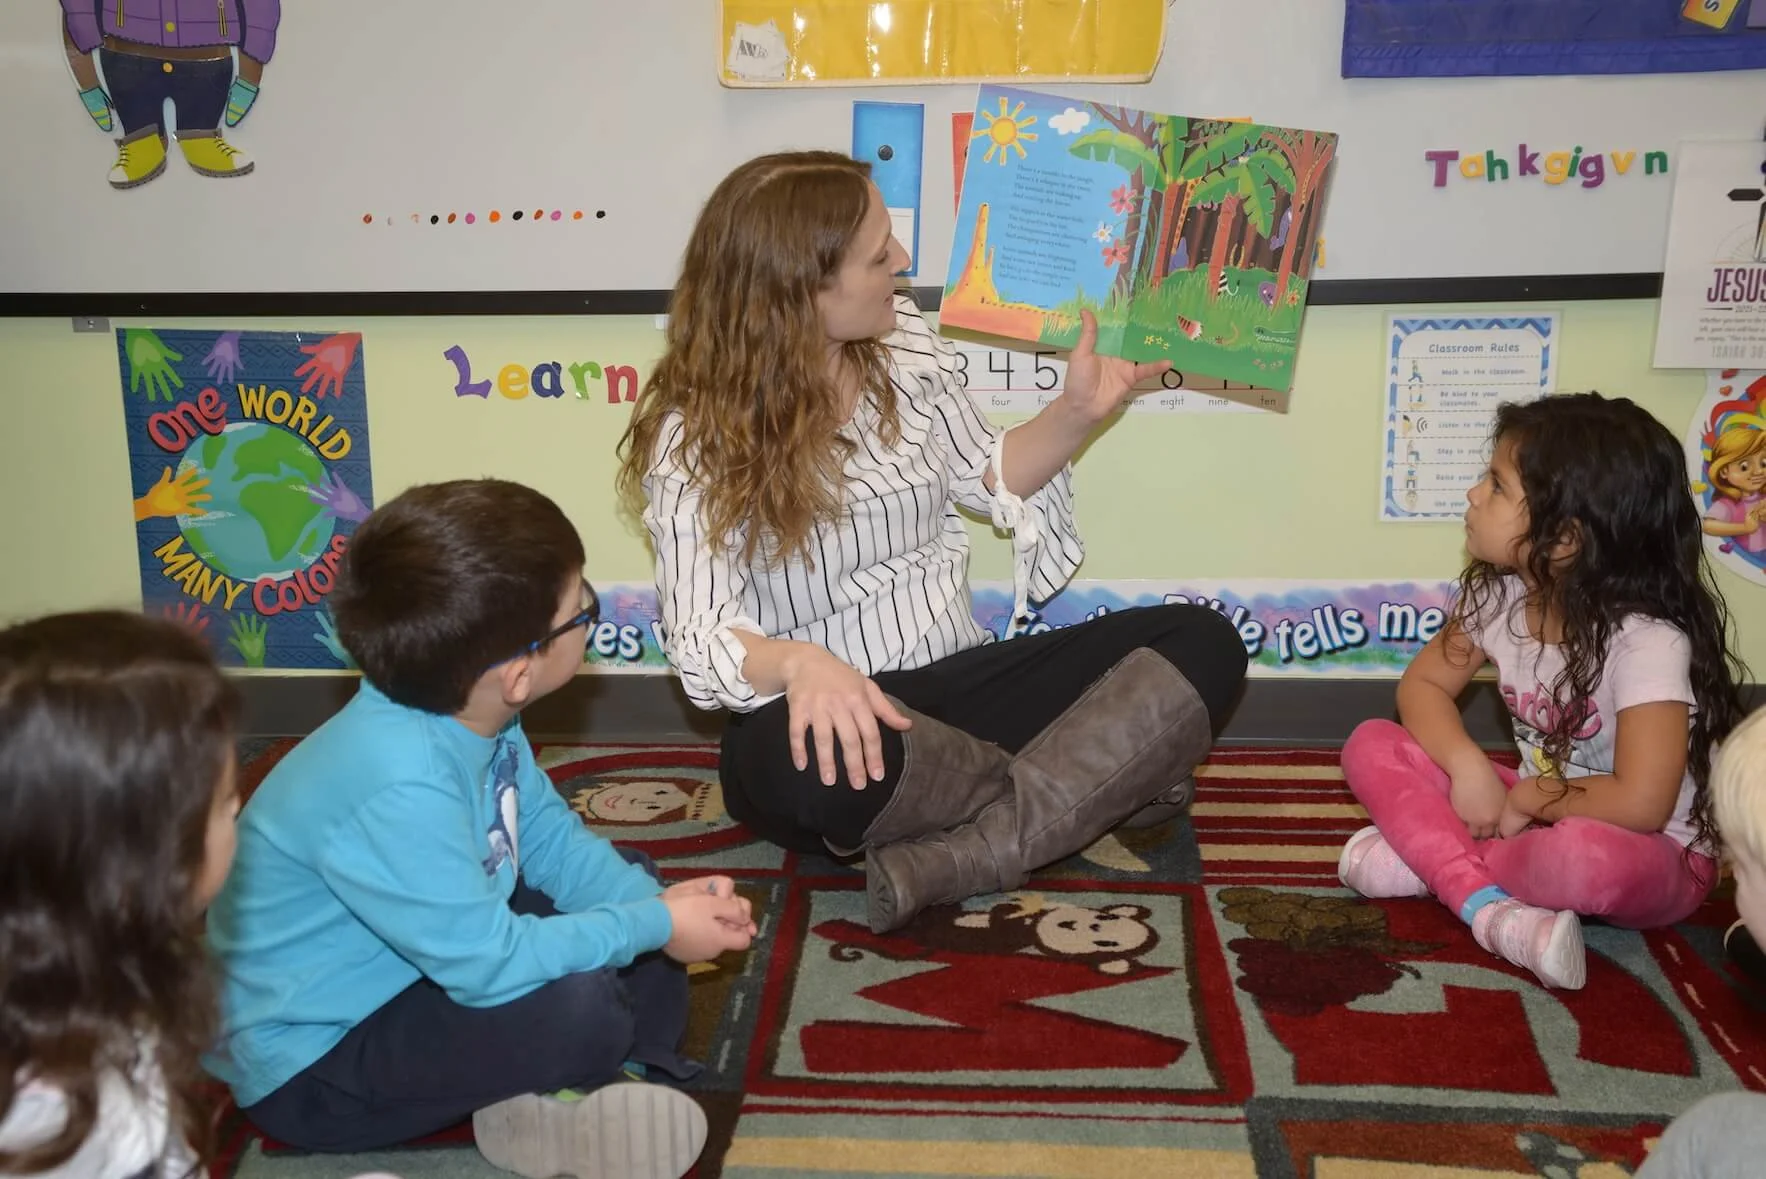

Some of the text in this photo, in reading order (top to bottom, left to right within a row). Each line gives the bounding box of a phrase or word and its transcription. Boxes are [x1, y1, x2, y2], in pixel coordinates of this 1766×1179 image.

[443, 344, 638, 404] Learn
[988, 351, 1015, 391] 4
[1035, 351, 1058, 390] 5
[1428, 343, 1520, 353] Classroom Rules
[148, 383, 352, 460] One WORLD
[991, 395, 1011, 406] four
[1038, 395, 1049, 406] fiv
[1160, 397, 1185, 409] eight
[1208, 398, 1229, 406] nine
[1260, 396, 1276, 406] ten
[153, 536, 247, 610] MANY
[1275, 603, 1368, 663] tells
[1379, 602, 1447, 644] me
